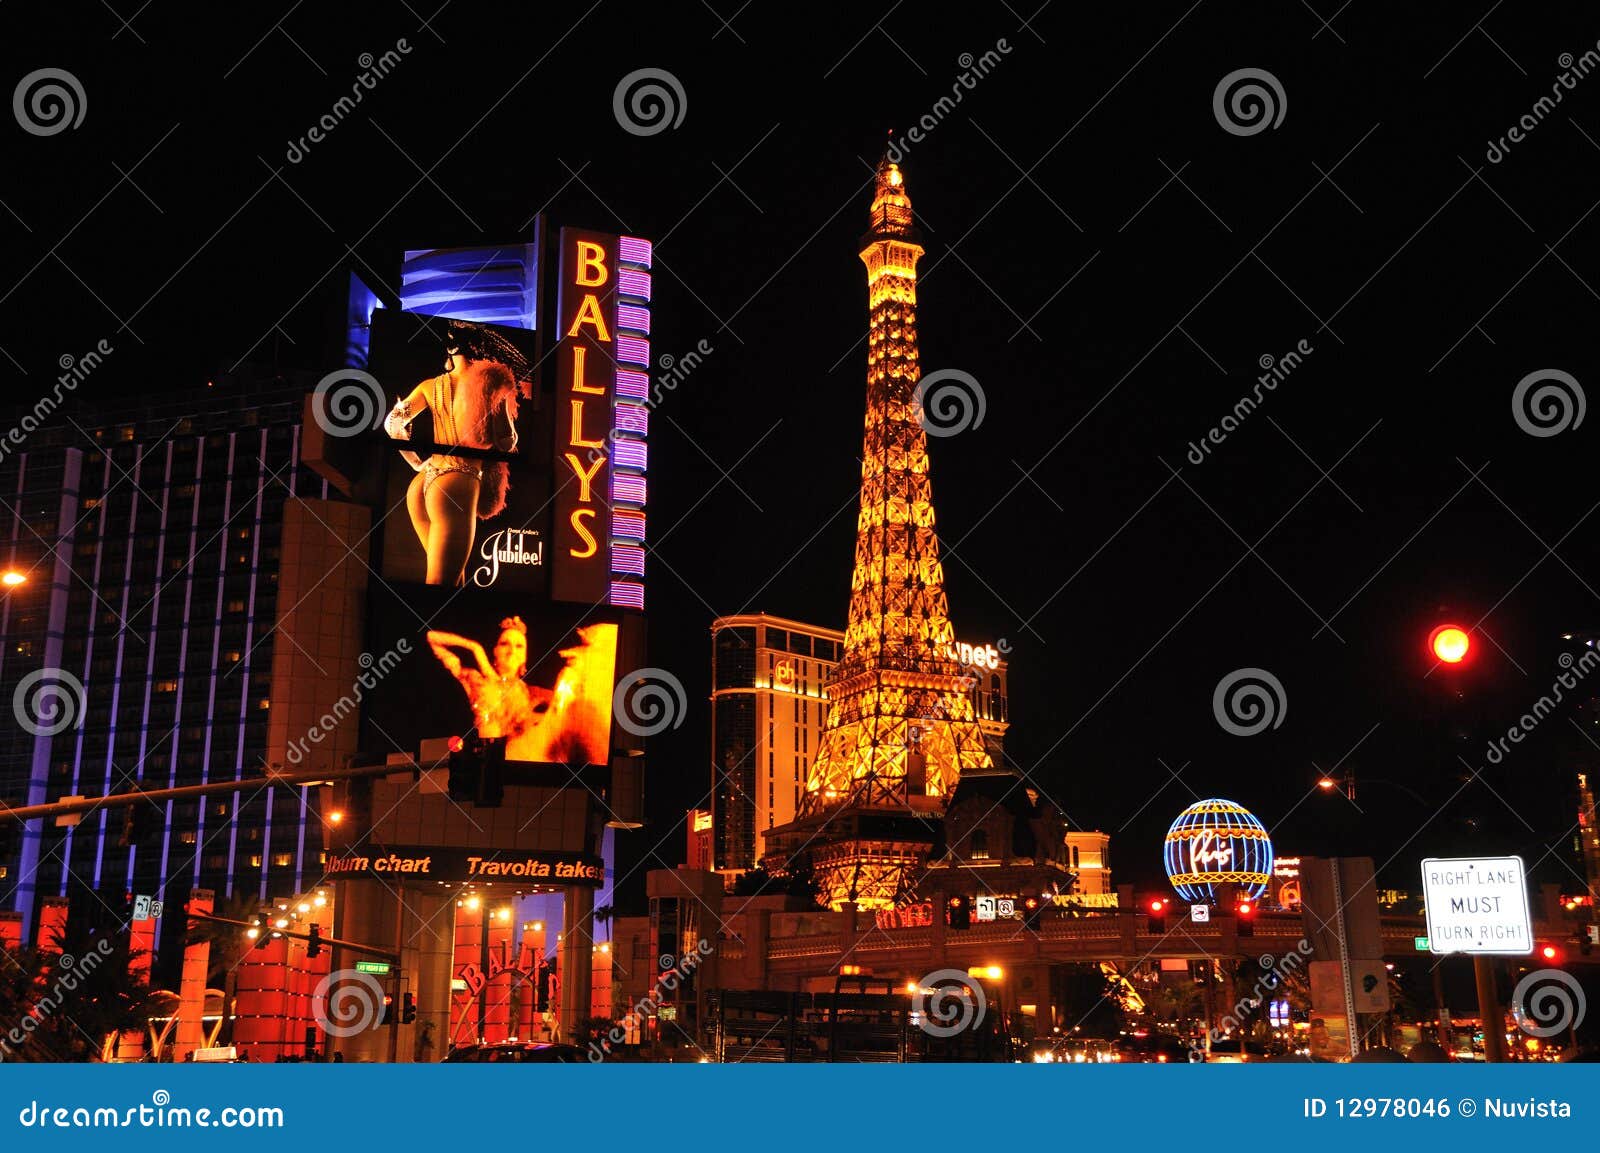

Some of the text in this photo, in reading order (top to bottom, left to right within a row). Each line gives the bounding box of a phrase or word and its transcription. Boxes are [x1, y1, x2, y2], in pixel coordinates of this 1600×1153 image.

[566, 240, 611, 558] BALLYS
[474, 530, 542, 587] Jubilee!
[374, 854, 430, 873] chart
[467, 857, 549, 877] Travolta
[1431, 870, 1517, 885] RIGHT LANE
[1451, 896, 1502, 914] MUST
[1436, 924, 1524, 940] TURN RIGHT
